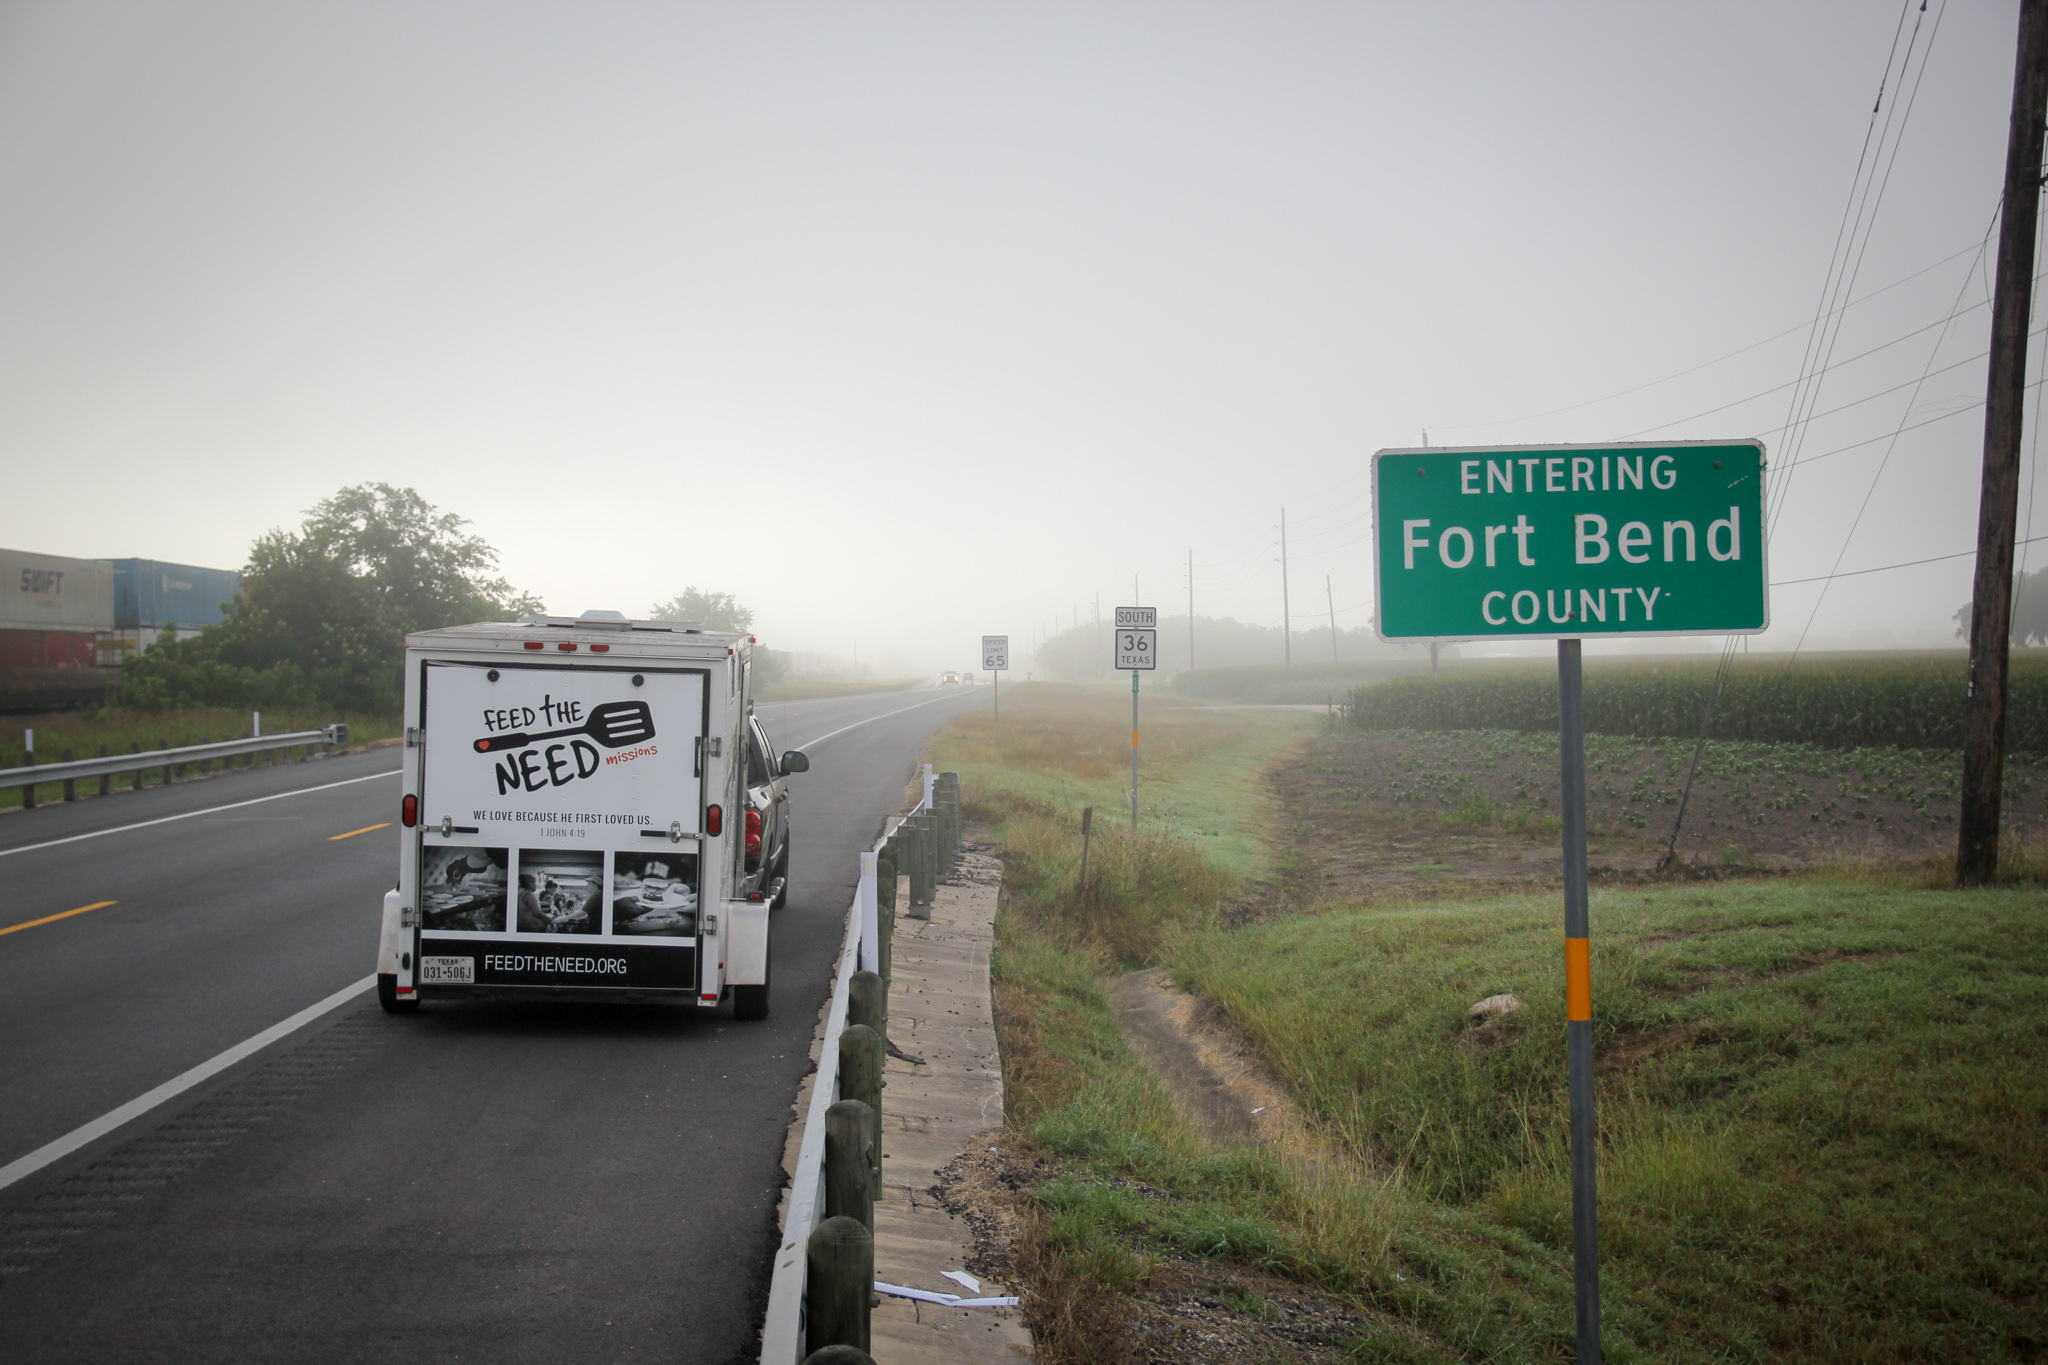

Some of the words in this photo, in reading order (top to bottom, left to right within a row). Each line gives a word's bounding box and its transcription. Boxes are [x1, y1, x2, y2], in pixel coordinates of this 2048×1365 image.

[1460, 454, 1677, 495] ENTERING
[1402, 514, 1536, 570] Fort
[1574, 505, 1742, 565] Bend
[1481, 586, 1661, 626] COUNTY
[1118, 611, 1153, 623] SOUTH
[1123, 634, 1148, 652] 36
[986, 655, 1005, 667] 65
[1121, 655, 1150, 664] TEXAS
[483, 707, 536, 732] FEED
[605, 745, 658, 765] missions
[495, 739, 600, 795] NEED
[473, 810, 487, 821] WE
[489, 810, 513, 821] LOVE
[515, 811, 558, 823] BECAUSE
[561, 812, 573, 823] HE
[575, 813, 602, 824] FIRST
[605, 814, 634, 825] LOVED
[637, 815, 653, 826] US.
[546, 828, 567, 838] JOHN
[569, 829, 586, 838] 4:19
[484, 954, 627, 974] FEEDTHENEED.ORG
